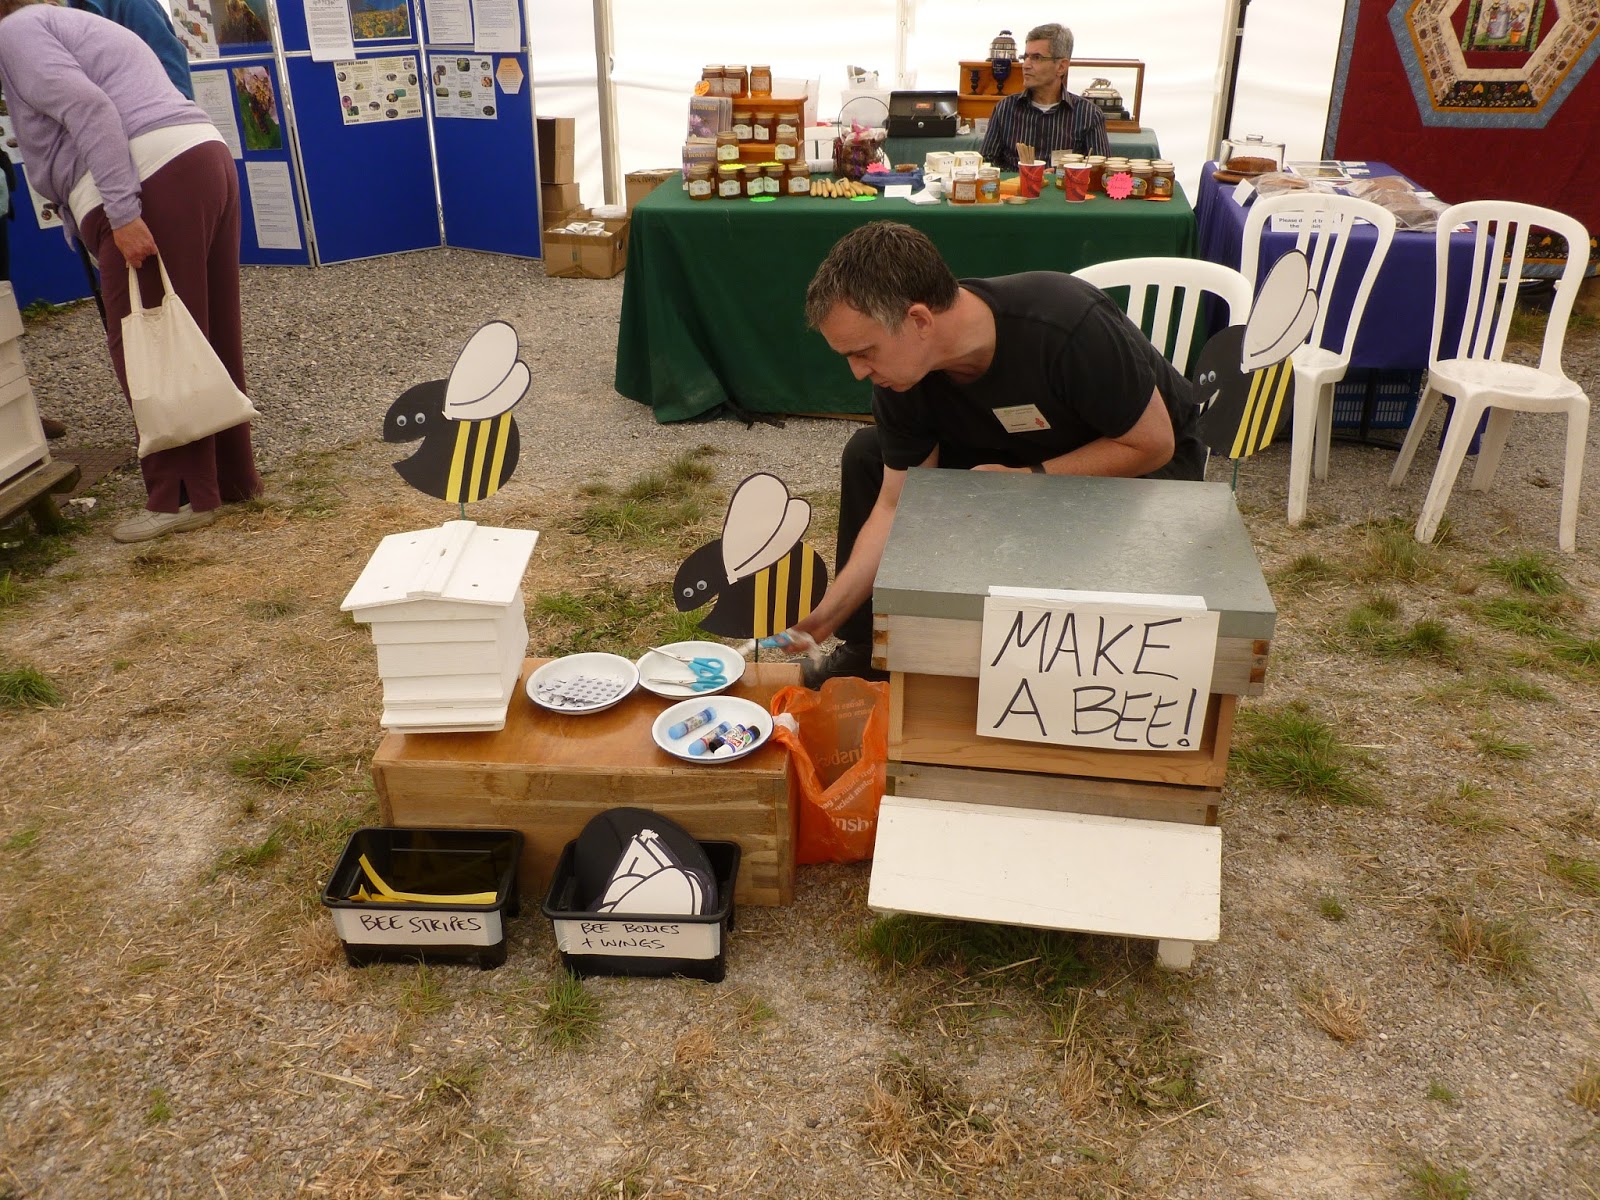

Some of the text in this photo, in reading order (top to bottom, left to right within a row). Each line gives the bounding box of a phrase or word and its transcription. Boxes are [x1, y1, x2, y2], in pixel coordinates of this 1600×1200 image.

[990, 610, 1183, 681] MAKE
[992, 677, 1197, 749] A BEE!
[360, 914, 482, 933] BEE STRIPES
[580, 922, 680, 935] BEE BODIES
[600, 938, 665, 950] WINGS
